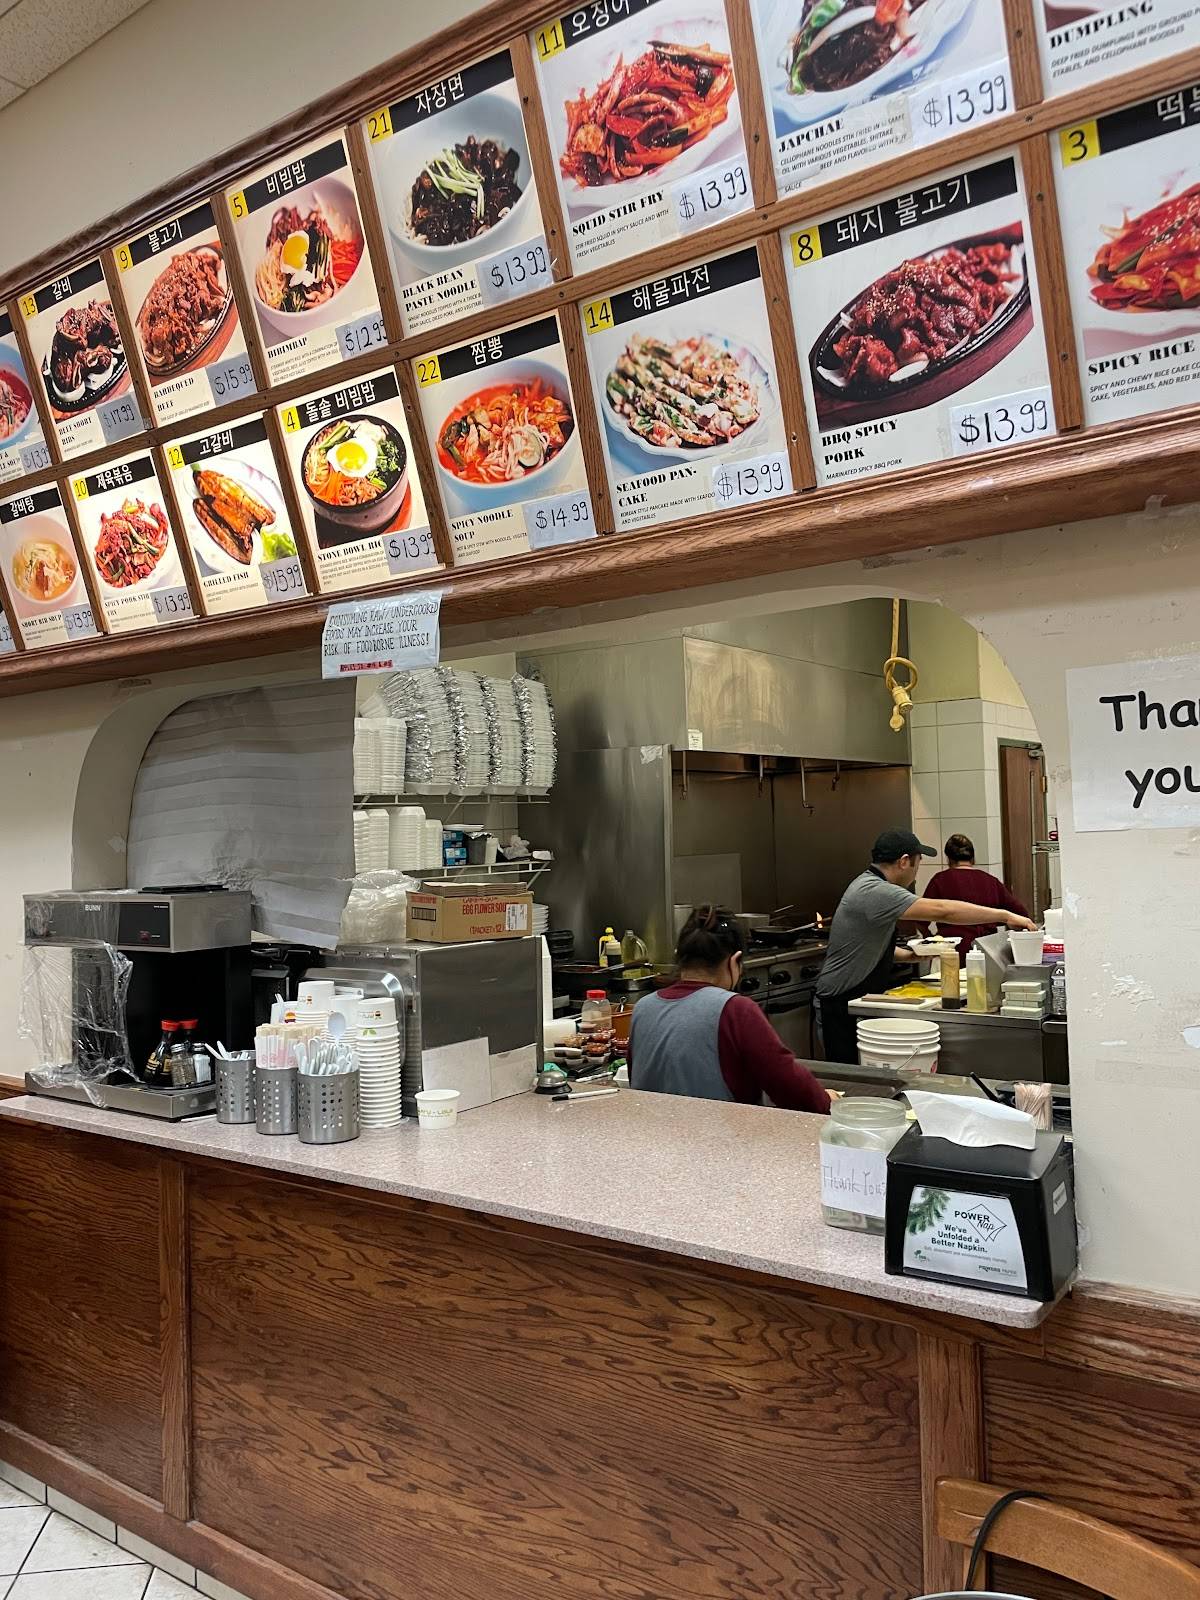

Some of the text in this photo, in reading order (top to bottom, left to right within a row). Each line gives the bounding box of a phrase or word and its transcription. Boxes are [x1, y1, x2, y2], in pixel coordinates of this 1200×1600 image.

[1050, 0, 1153, 48] DUMPLING
[538, 26, 562, 56] 11
[1084, 55, 1100, 67] AND
[369, 73, 464, 138] 21 자장면
[779, 118, 844, 153] JAPCHAE
[1068, 130, 1087, 161] 3
[781, 149, 814, 166] CELLOPHANE
[816, 139, 841, 152] NOODLES
[792, 162, 806, 171] WITH
[808, 152, 831, 166] VARIOUS
[820, 155, 846, 170] BEEF AND
[234, 160, 306, 217] 5 비빔밥
[573, 190, 663, 236] SQUID STIR FRY
[798, 175, 971, 261] 8 돼지 불고기
[597, 232, 610, 240] SQUID
[617, 225, 629, 233] SPICY
[630, 219, 643, 228] SAUCE
[120, 220, 183, 269] 9 불고기
[403, 269, 462, 298] BLACK BEAN
[22, 276, 72, 315] 13 갈비
[406, 279, 477, 312] PASTE NOODLE
[587, 265, 711, 328] 14 해물파전
[268, 337, 307, 358] BIBIMBAP
[1088, 340, 1195, 376] SPICY RICE
[419, 336, 503, 382] 22 짬뽕
[1090, 384, 1108, 393] SPICY
[1110, 379, 1126, 388] AND
[1127, 372, 1153, 384] CHEWY
[1154, 369, 1169, 378] RICE
[1171, 364, 1190, 374] CAKE
[1112, 383, 1156, 397] VEGETABLES,
[1158, 378, 1174, 387] AND
[1175, 374, 1190, 383] RED
[158, 400, 173, 411] BEEF
[288, 412, 295, 429] 4
[335, 381, 375, 410] 비빔밥
[822, 419, 897, 447] BBQ SPICY
[169, 430, 233, 465] 12 고갈비
[824, 447, 864, 465] PORK
[826, 469, 857, 480] MARINATED
[859, 465, 872, 473] SPICY
[887, 458, 902, 466] PORK
[75, 481, 86, 497] 10
[616, 474, 666, 493] SEAFOOD
[10, 496, 34, 517] 갈비탕
[619, 493, 647, 507] CAKE
[452, 509, 513, 530] SPICY NOODLE
[454, 531, 474, 542] SOUP
[318, 541, 381, 561] STONE BOWL RIC
[204, 572, 249, 588] GRILLED FISH
[348, 626, 364, 638] MAY
[365, 622, 394, 636] INCREASE
[398, 620, 417, 632] YOUR
[324, 644, 338, 656] RISK
[344, 642, 351, 654] OF
[357, 638, 395, 653] FOODBORNE
[1099, 691, 1200, 732] Tha
[1125, 765, 1200, 809] you
[462, 902, 508, 915] EGG FLOWER SOU
[954, 1211, 990, 1222] POWER
[977, 1220, 994, 1231] Nap
[938, 1231, 972, 1242] Unfolded
[945, 1224, 966, 1234] We've
[931, 1238, 987, 1252] Better Napkin.
